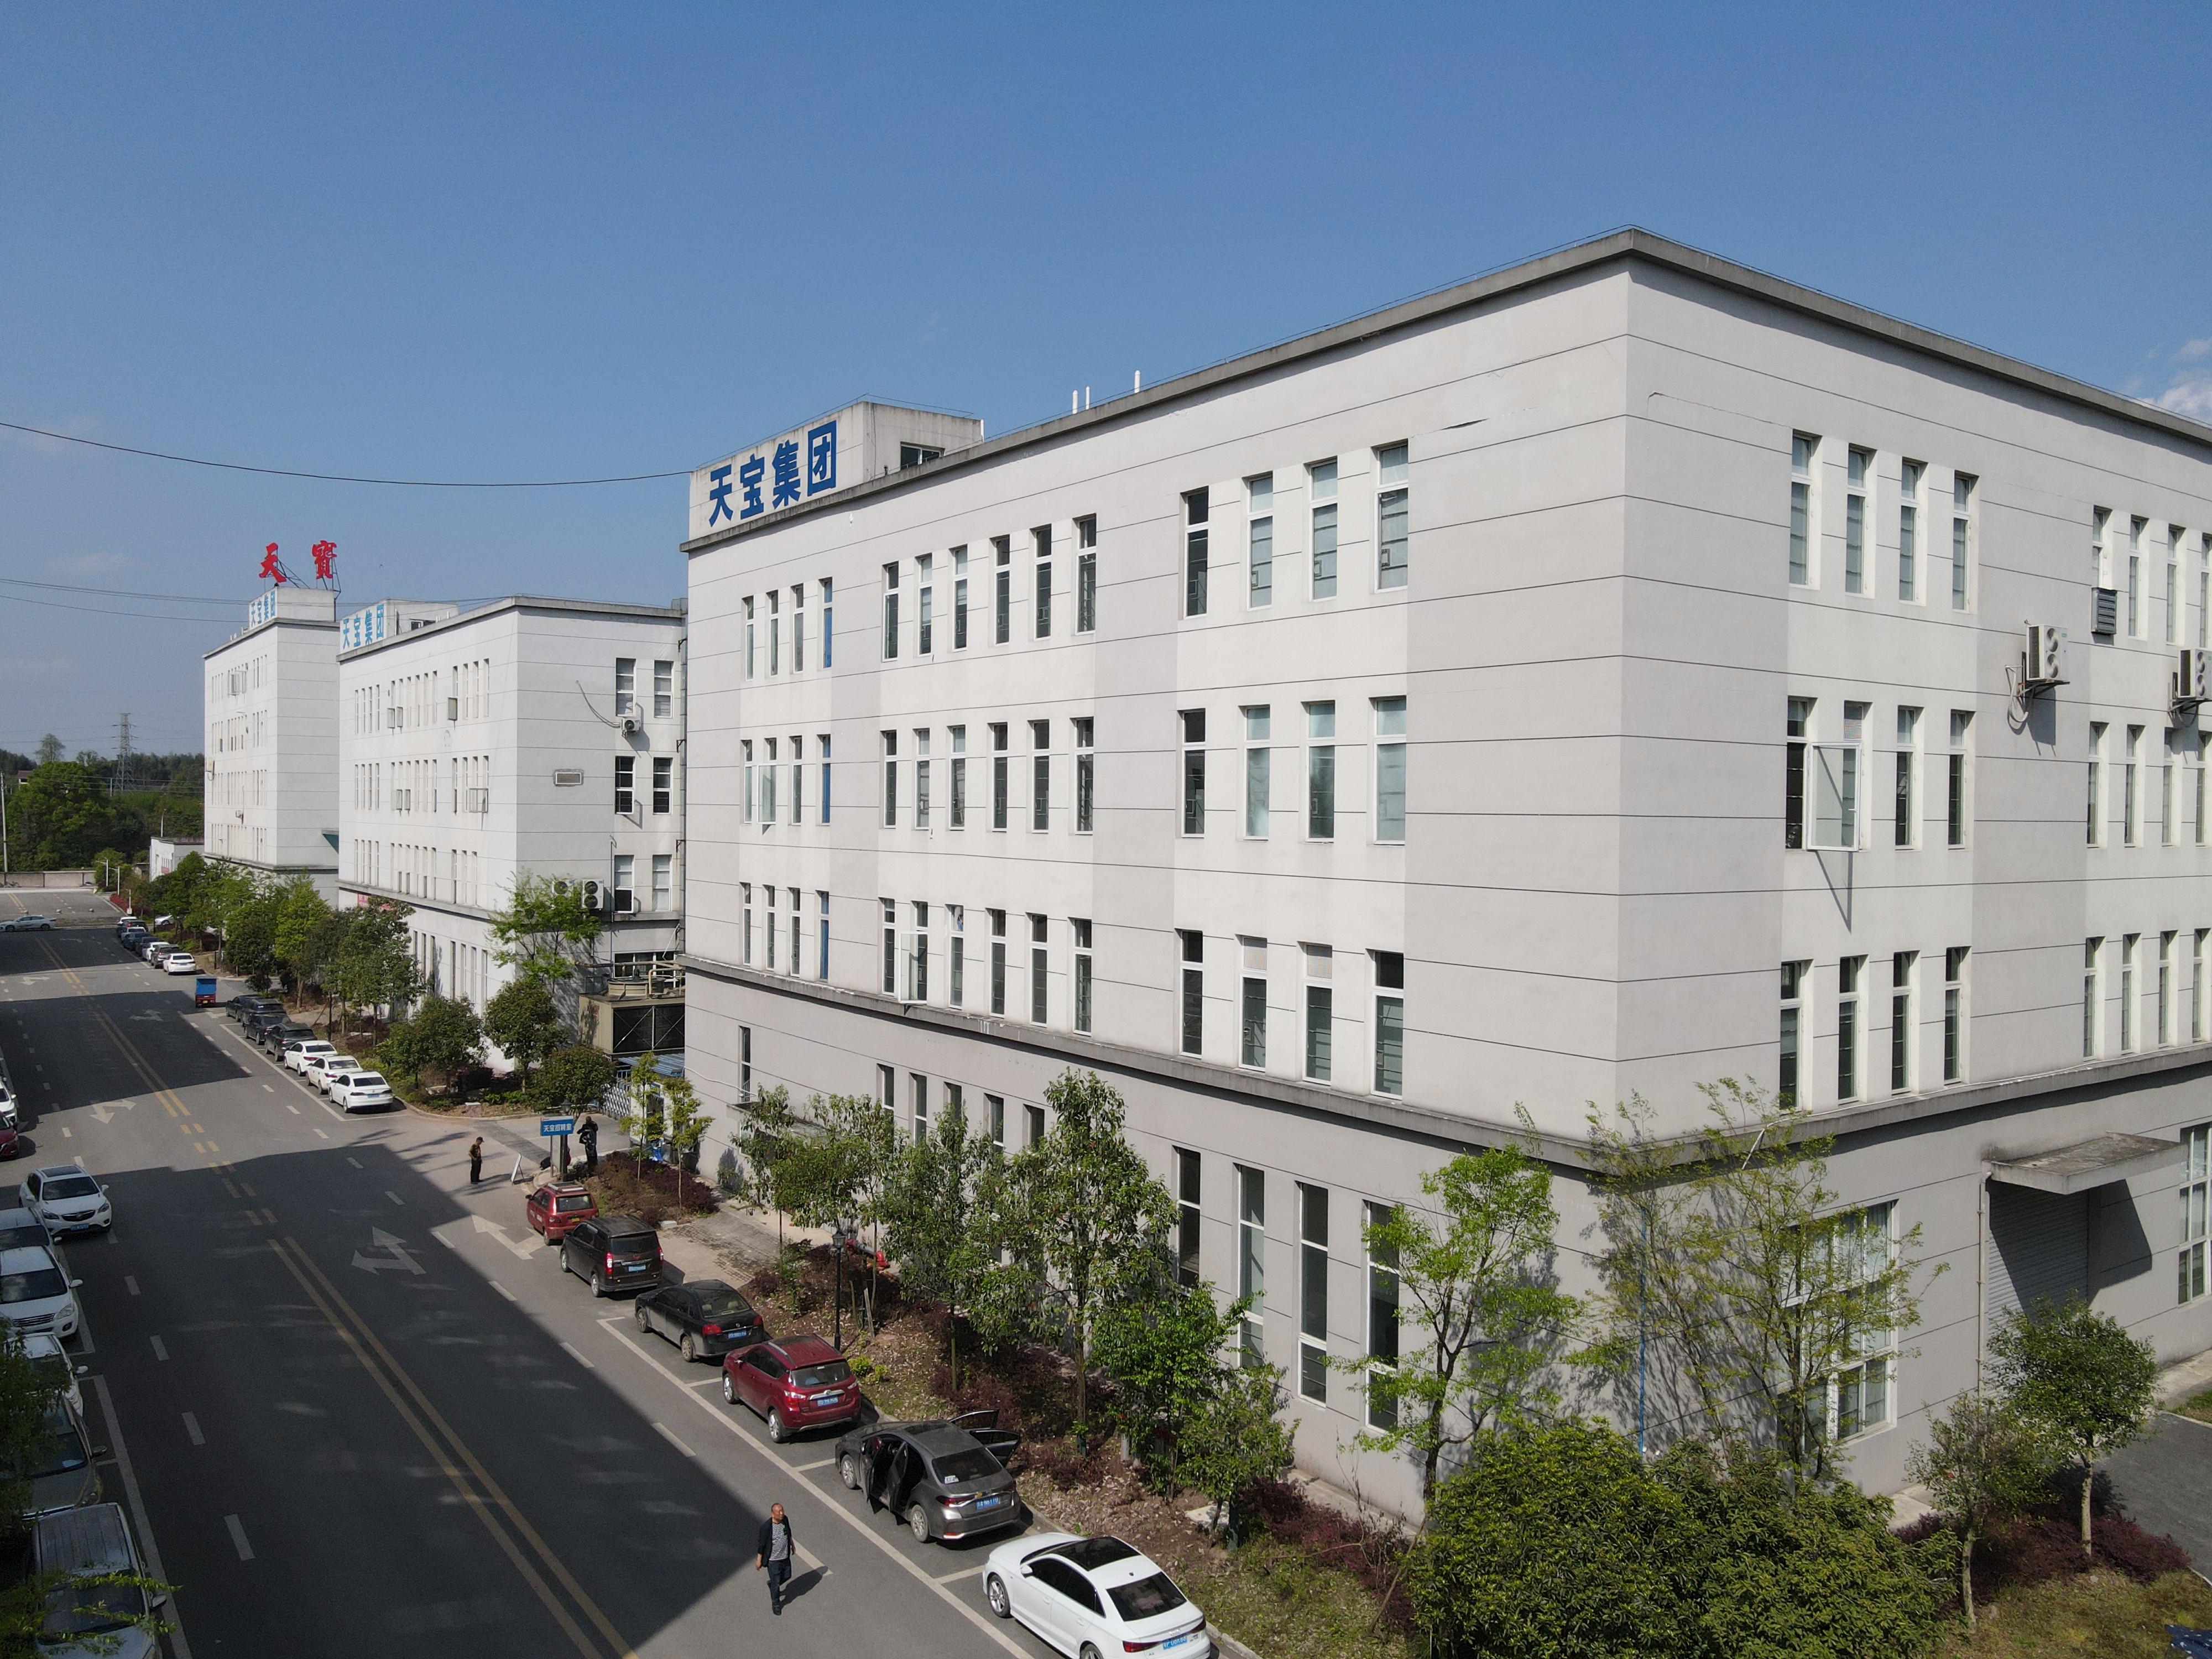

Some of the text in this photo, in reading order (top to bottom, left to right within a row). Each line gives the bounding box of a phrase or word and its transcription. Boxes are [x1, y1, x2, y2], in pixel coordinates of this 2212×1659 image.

[708, 420, 837, 527] 天宝集团
[342, 603, 384, 650] 天宝集团
